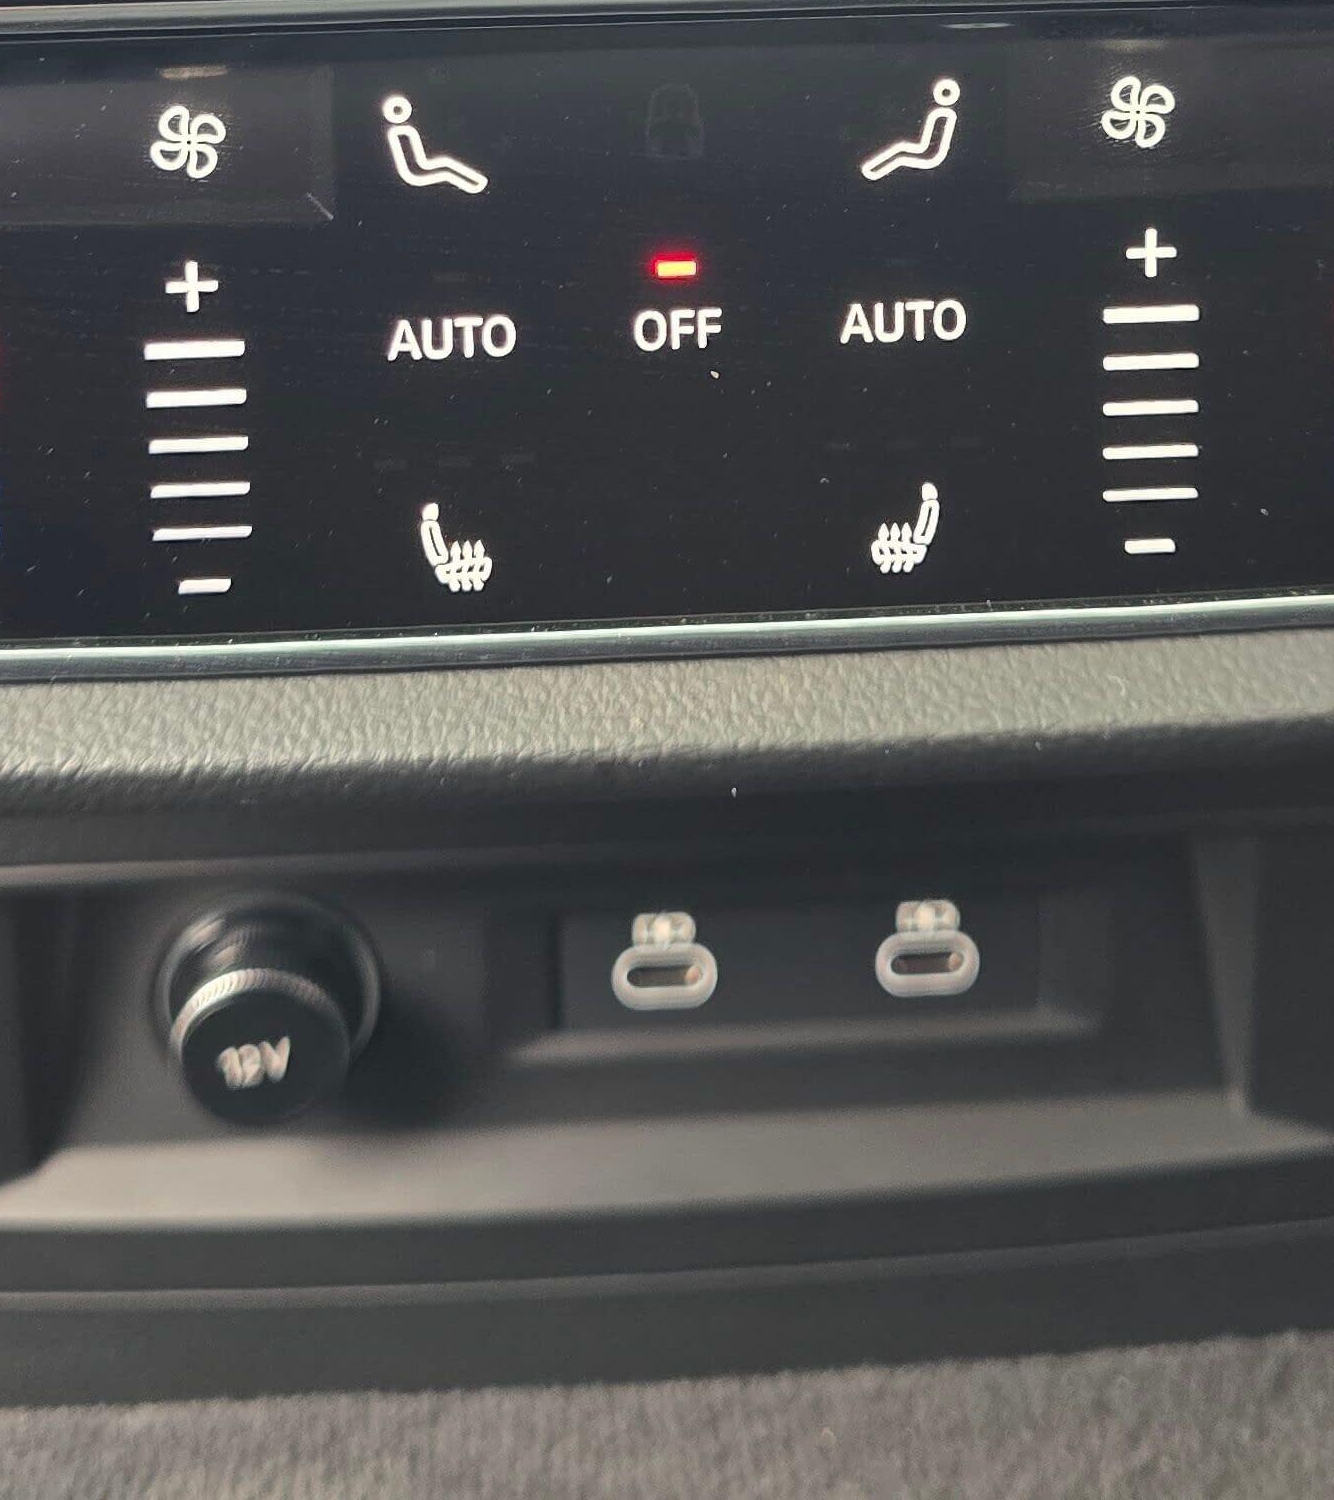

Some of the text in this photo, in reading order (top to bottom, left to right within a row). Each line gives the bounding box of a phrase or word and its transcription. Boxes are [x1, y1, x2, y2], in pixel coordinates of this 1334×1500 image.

[386, 311, 518, 363] AUTO
[630, 305, 725, 354] OFF
[838, 297, 968, 346] AUTO
